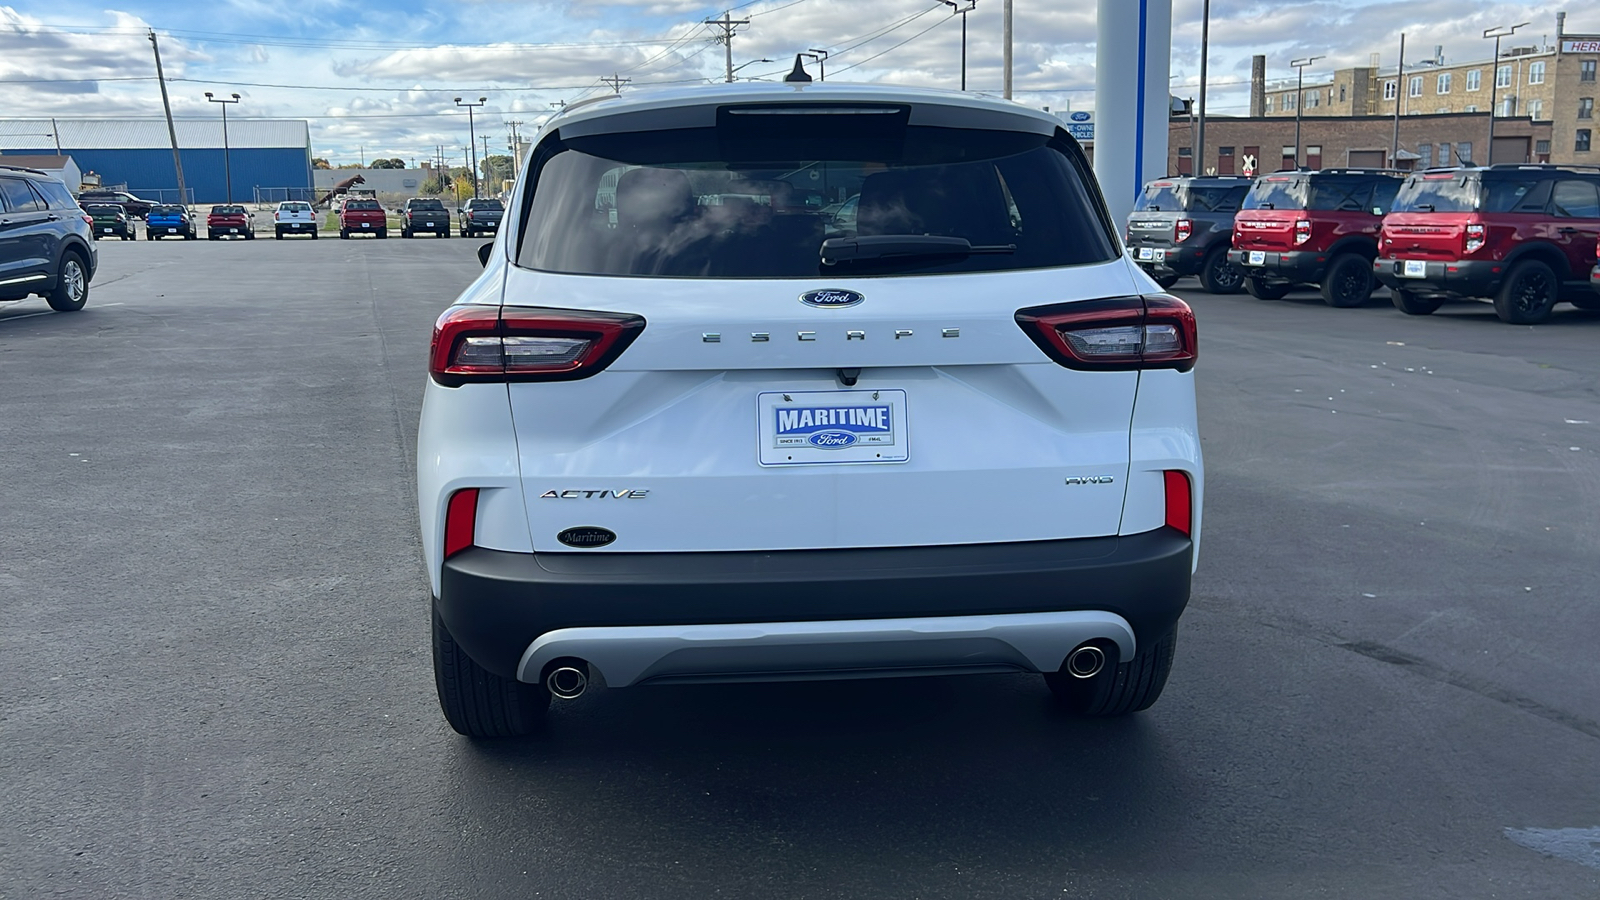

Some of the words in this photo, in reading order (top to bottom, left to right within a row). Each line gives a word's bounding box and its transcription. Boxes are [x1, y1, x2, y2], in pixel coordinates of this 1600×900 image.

[814, 290, 850, 304] Ford
[702, 329, 960, 342] ESCAPE
[778, 407, 888, 433] MARITIME
[817, 433, 848, 445] Ford
[1065, 475, 1114, 485] AWD
[539, 489, 650, 499] ACTIVE
[564, 531, 610, 543] Maritime
